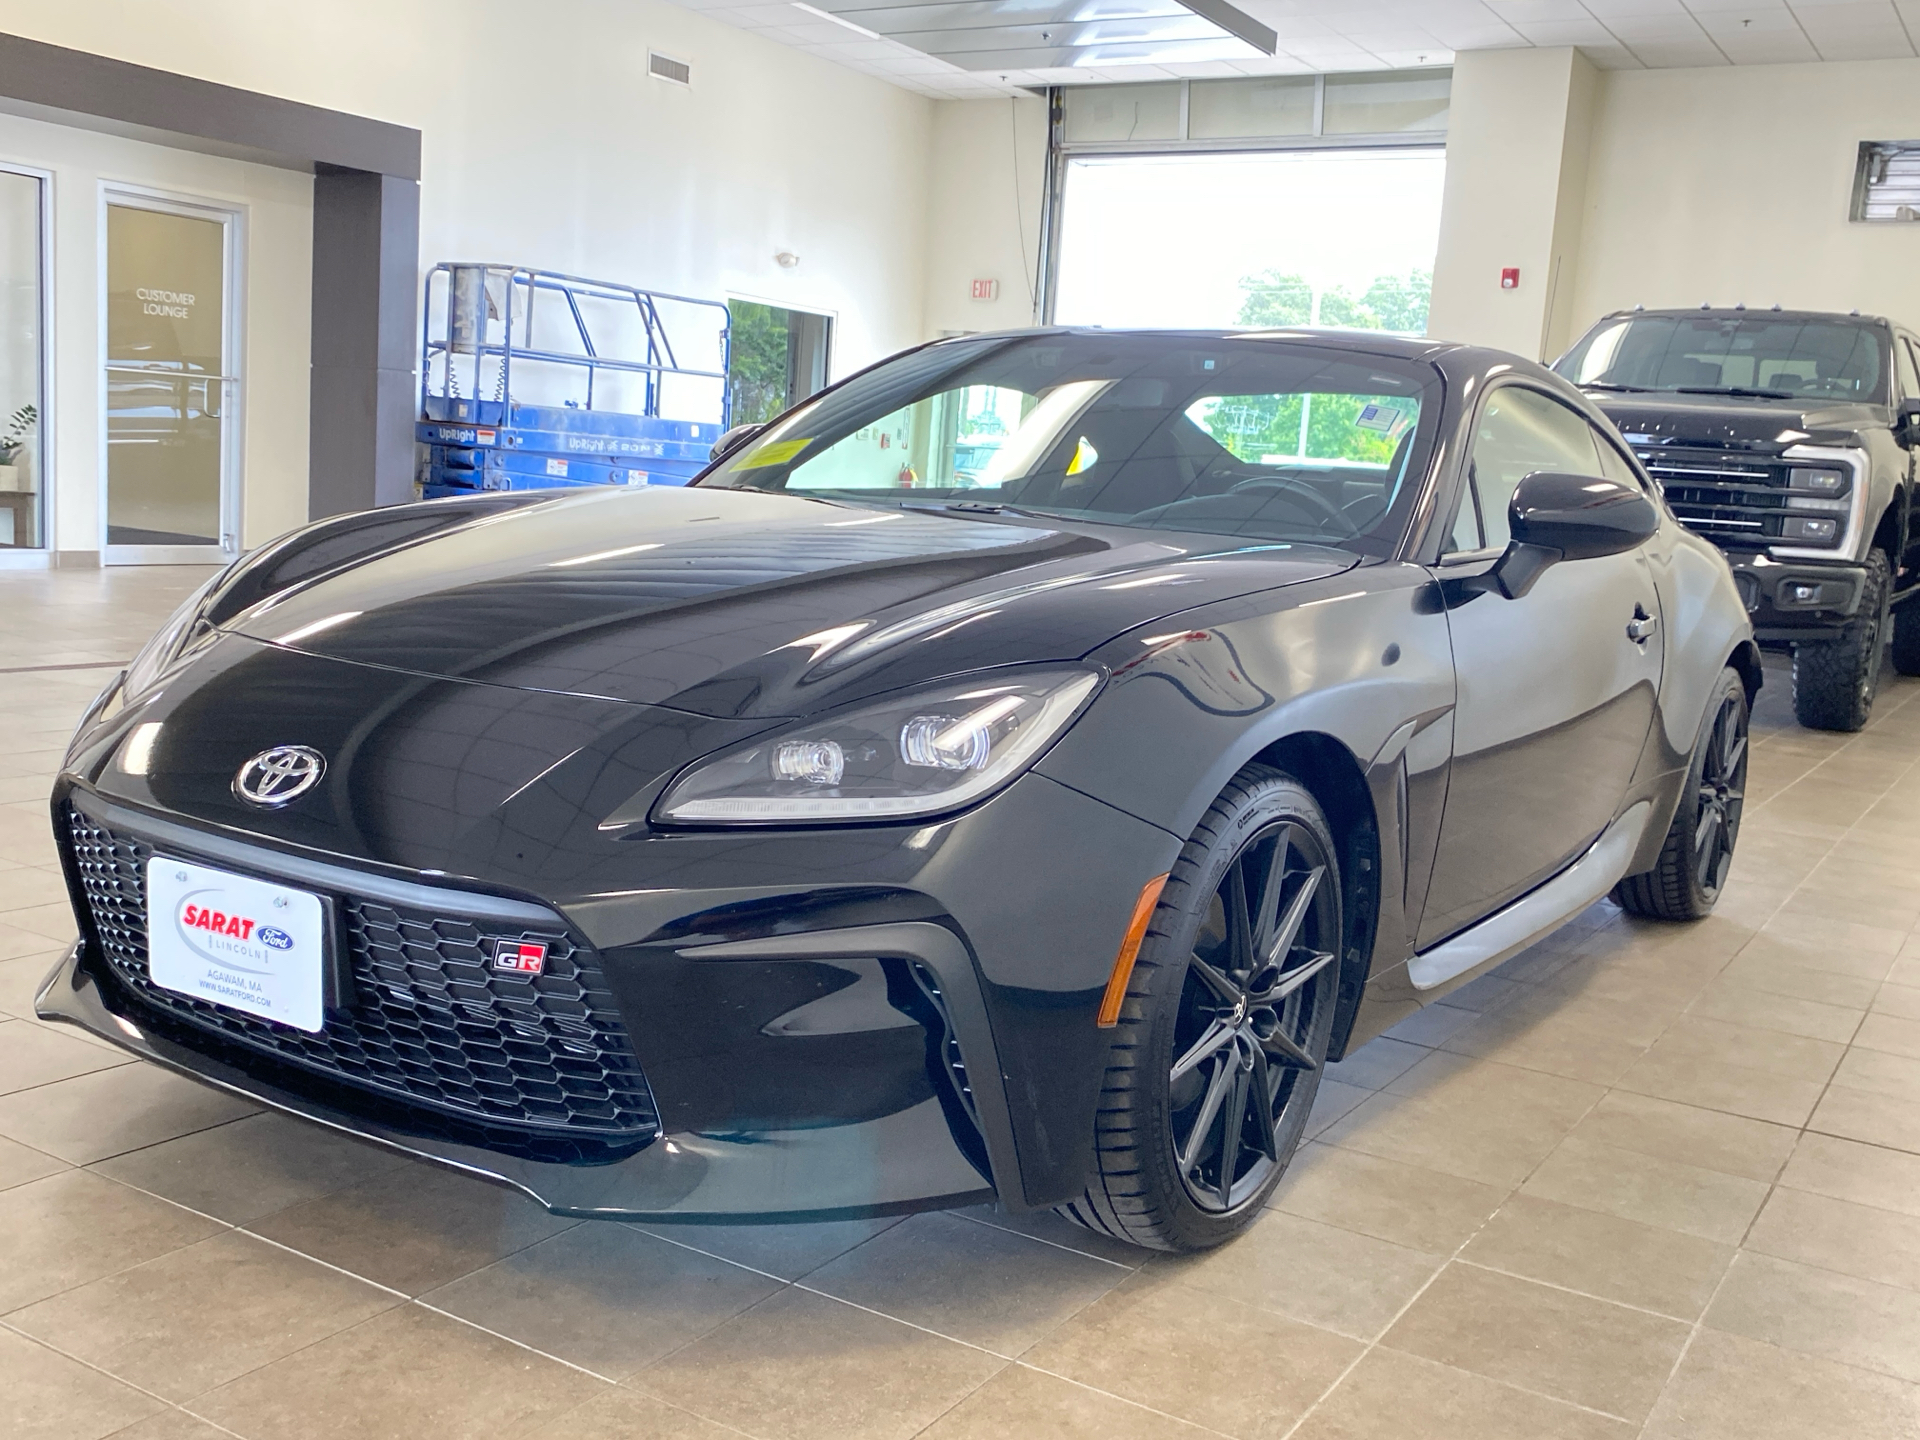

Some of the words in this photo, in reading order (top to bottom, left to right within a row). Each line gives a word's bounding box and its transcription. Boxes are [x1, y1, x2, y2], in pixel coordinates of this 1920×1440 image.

[136, 288, 195, 306] CUSTOMER
[972, 279, 993, 299] EXIT
[143, 303, 189, 319] LOUNGE
[439, 428, 475, 443] UpRight
[569, 437, 604, 452] UpRight
[183, 905, 254, 940] SARAT
[262, 928, 288, 949] Ford
[215, 939, 261, 959] LINCOLN
[497, 952, 540, 970] GR
[207, 969, 247, 990] AGAWAM,
[249, 980, 263, 993] MA
[198, 979, 271, 1007] WWW.SARATFORD.COM
